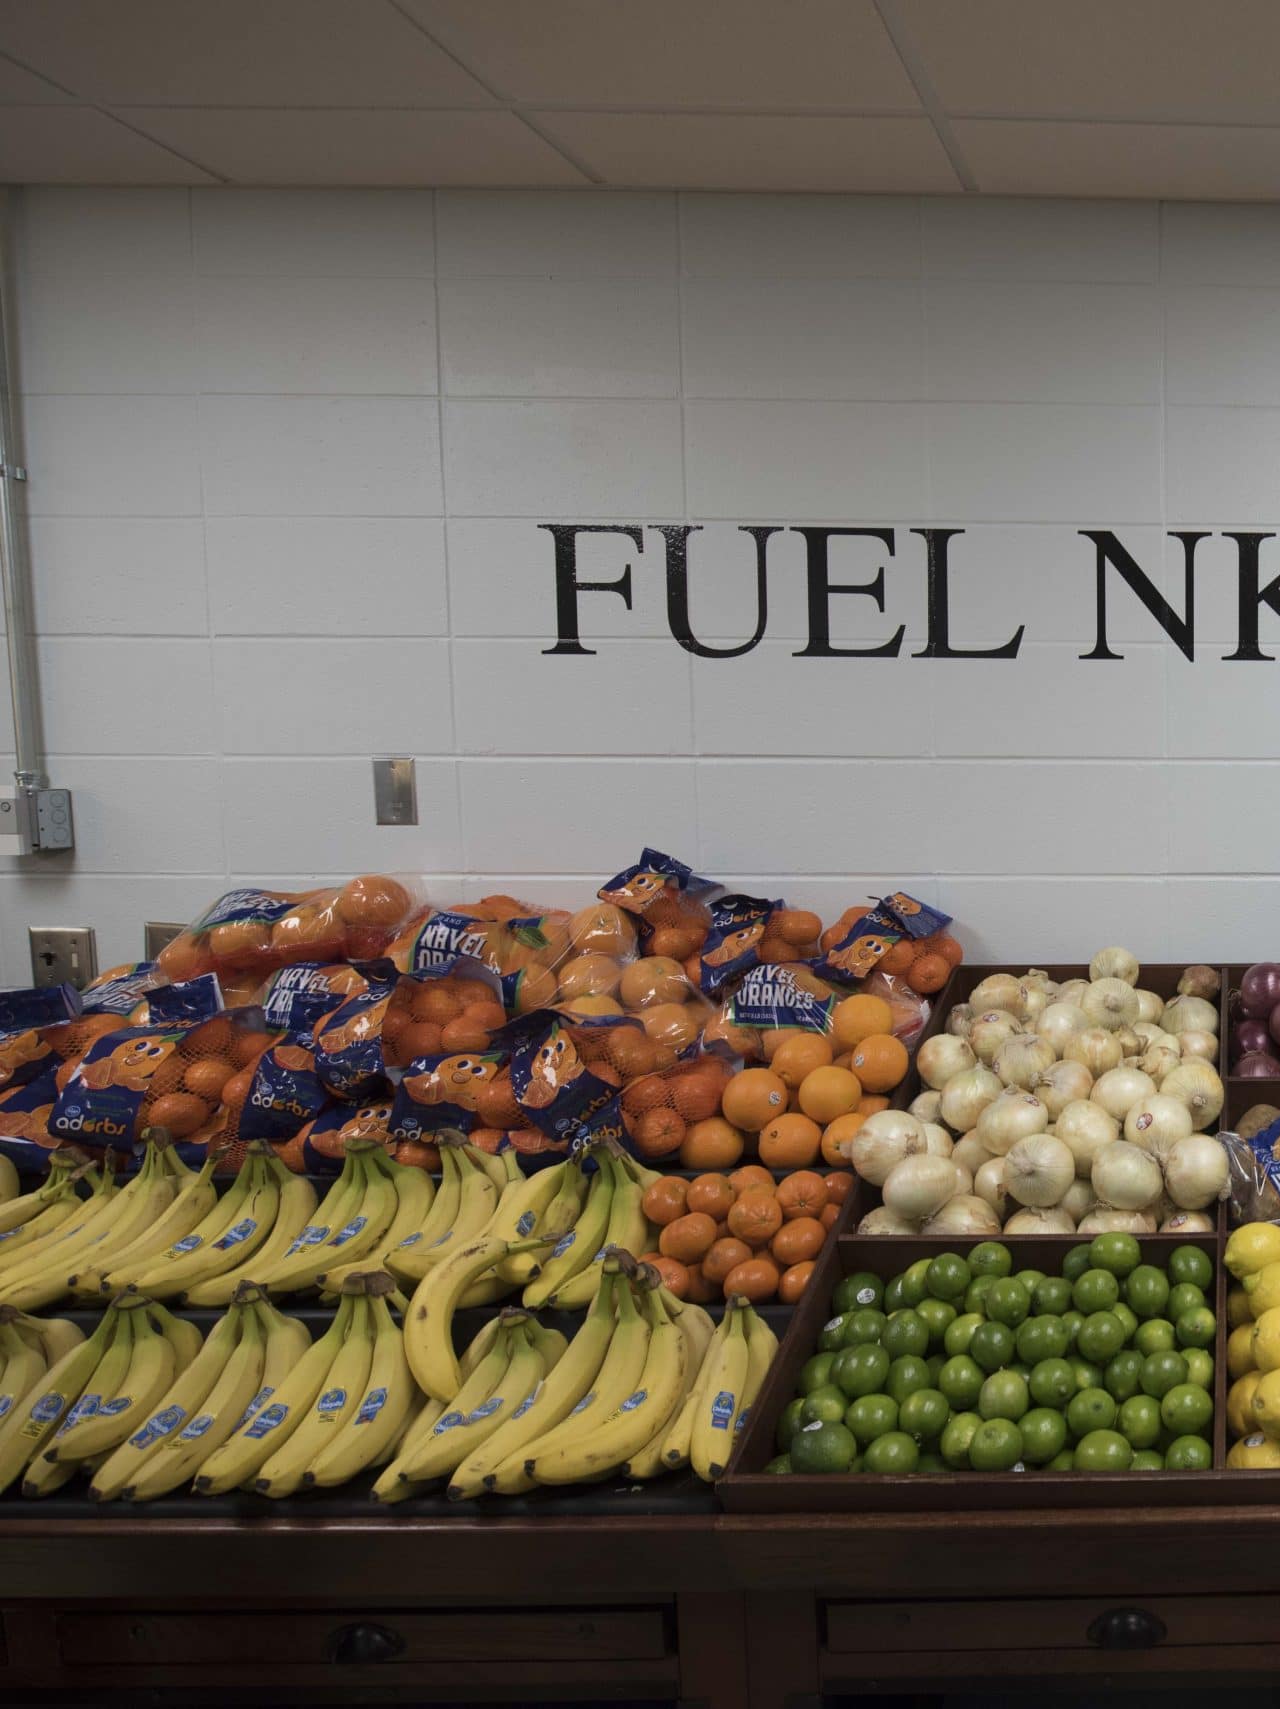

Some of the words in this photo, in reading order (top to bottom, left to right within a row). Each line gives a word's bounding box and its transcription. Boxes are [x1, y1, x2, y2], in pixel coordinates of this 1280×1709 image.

[537, 524, 1026, 659] FUEL
[420, 924, 488, 960] NAVEL
[274, 968, 330, 992] NAVEL
[736, 982, 816, 1009] ORANGES
[252, 1092, 312, 1118] adorbs
[56, 1114, 127, 1136] adorbs
